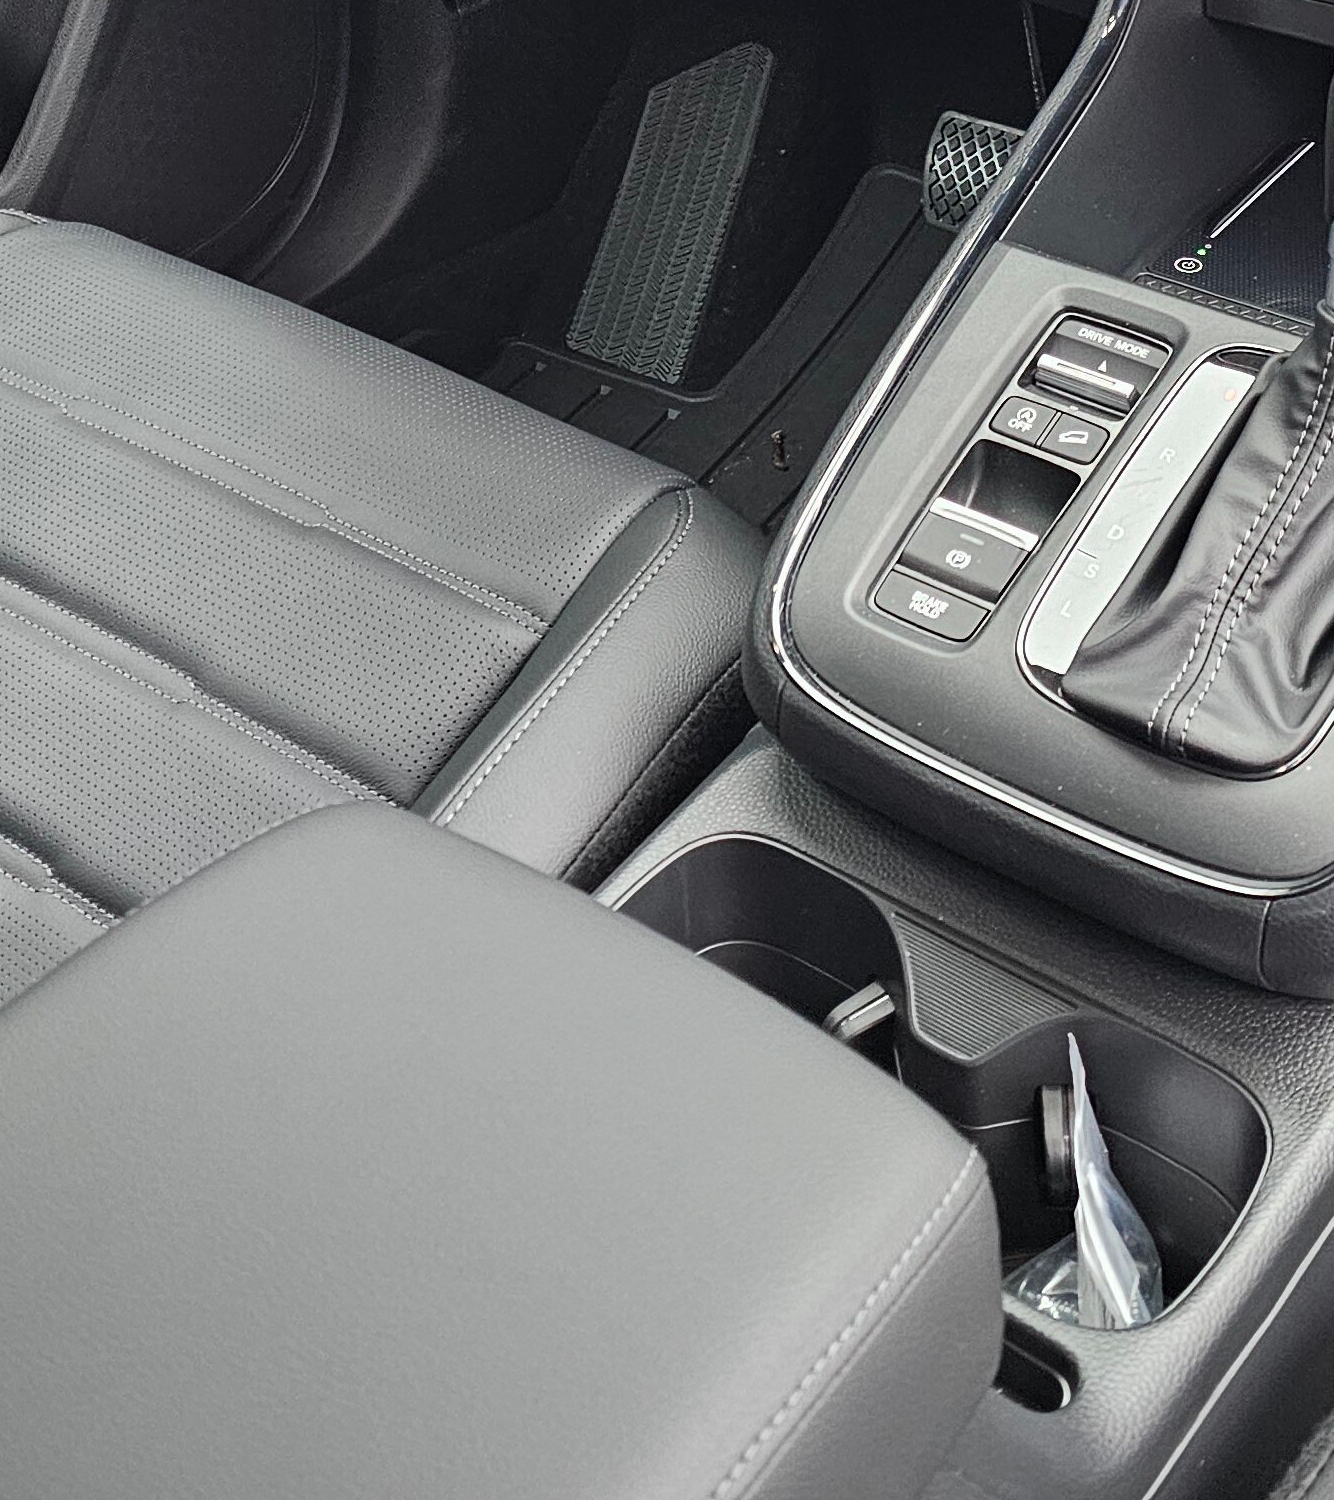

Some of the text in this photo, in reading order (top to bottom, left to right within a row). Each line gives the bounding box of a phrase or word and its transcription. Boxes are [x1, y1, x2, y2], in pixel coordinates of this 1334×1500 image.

[1077, 327, 1151, 359] DRIVE MODE
[1007, 417, 1033, 433] OFF
[1159, 448, 1176, 464] R
[1106, 524, 1125, 541] D
[1083, 563, 1100, 580] S
[908, 600, 942, 620] HOLD
[911, 590, 950, 613] BRAKE
